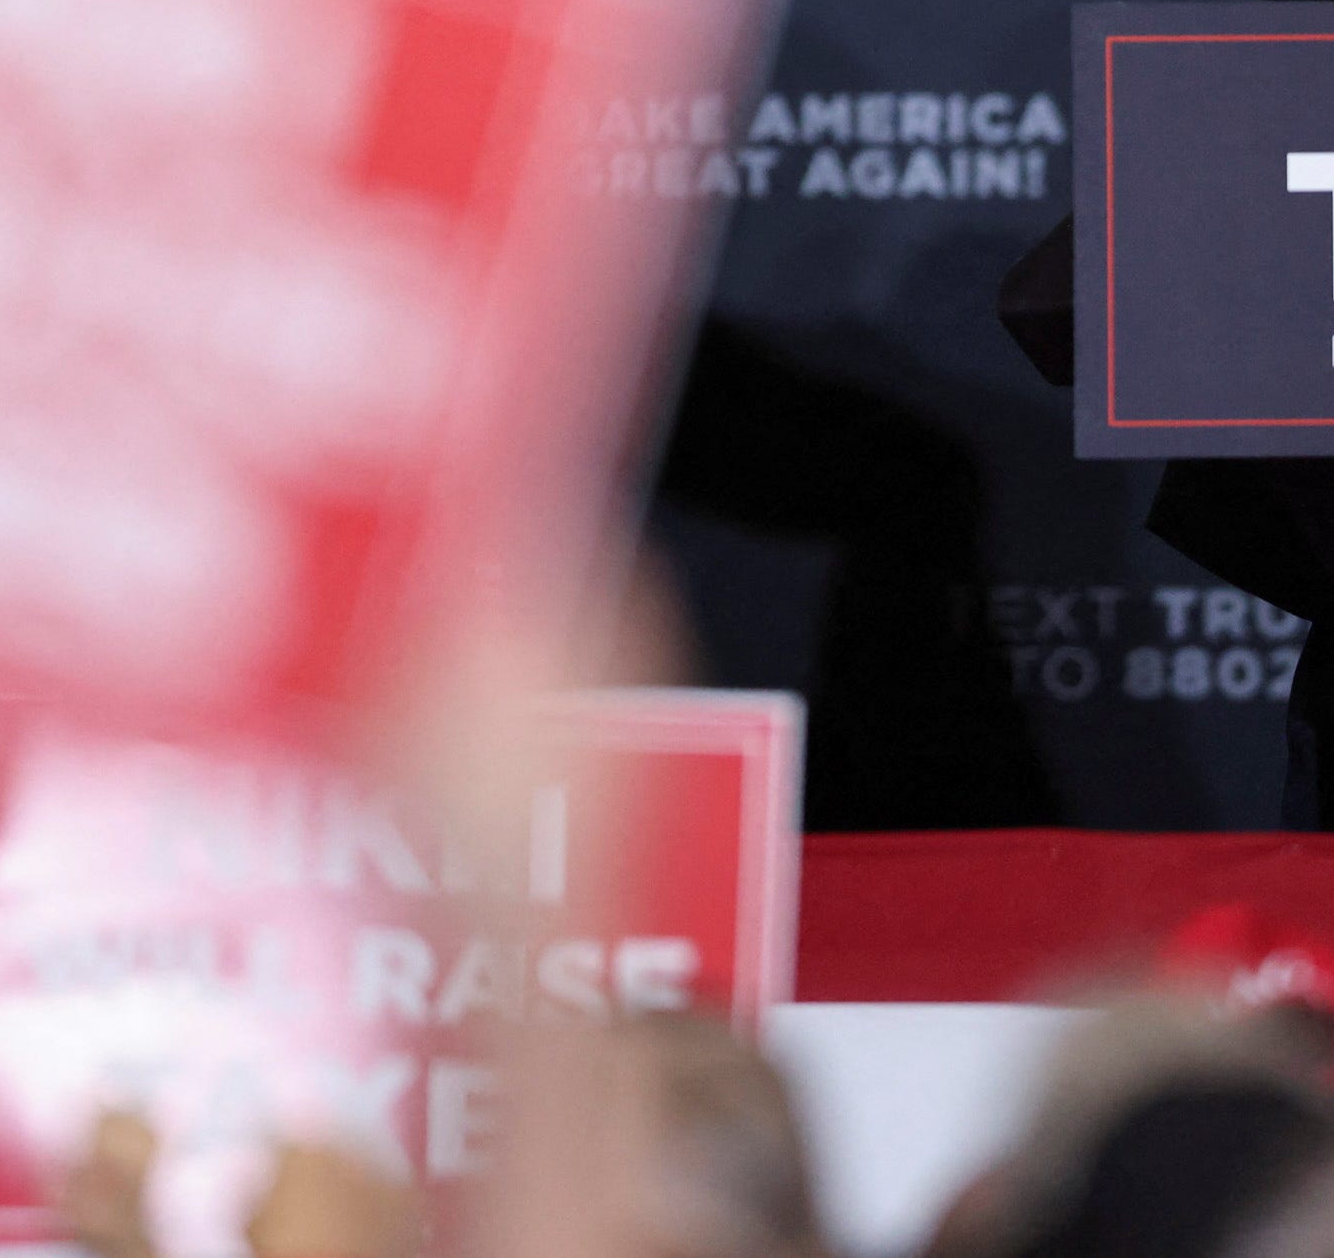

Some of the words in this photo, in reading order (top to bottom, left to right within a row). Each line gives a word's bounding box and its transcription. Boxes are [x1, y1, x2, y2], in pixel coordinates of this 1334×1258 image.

[579, 92, 727, 145] AKE
[748, 91, 1067, 146] AMERICA
[799, 147, 1049, 200] AGAIN!
